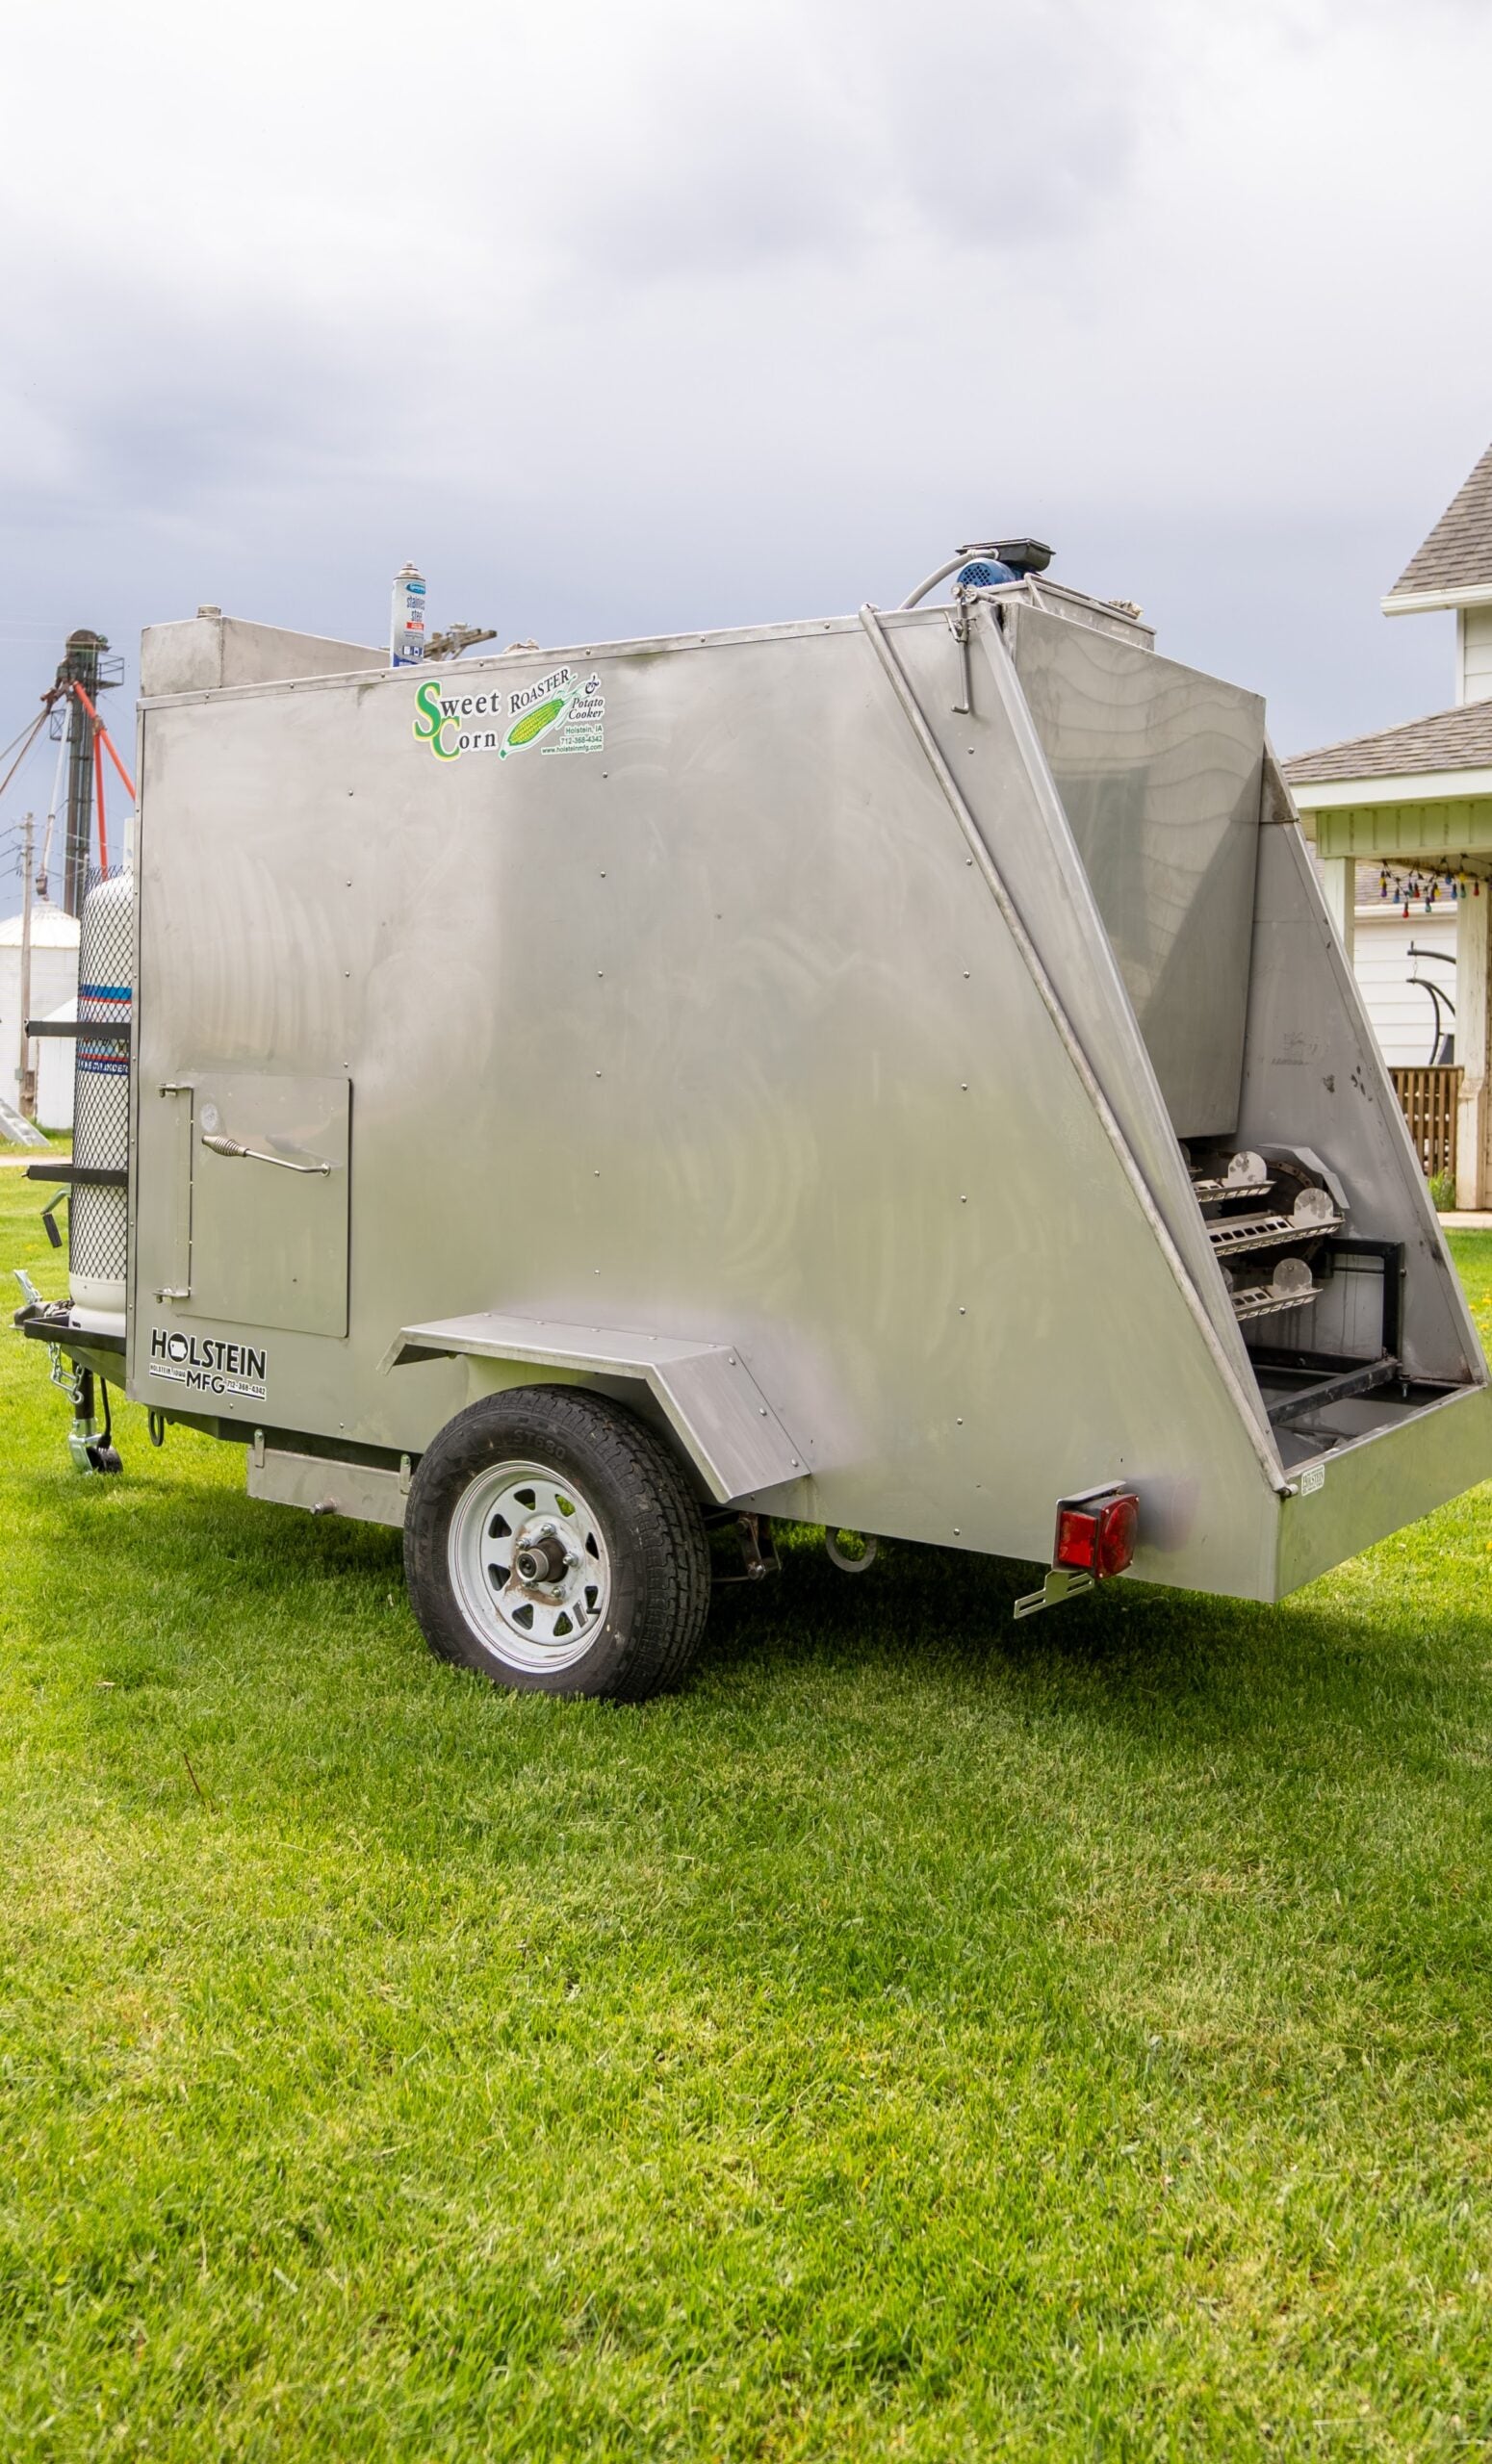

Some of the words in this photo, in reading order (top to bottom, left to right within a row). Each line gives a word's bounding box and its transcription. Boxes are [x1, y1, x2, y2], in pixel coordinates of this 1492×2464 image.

[510, 669, 570, 714] ROASTER
[572, 697, 604, 709] Potato
[414, 681, 500, 739] Sweet
[568, 708, 604, 720] Cooker
[432, 715, 496, 760] Corn
[560, 735, 603, 745] 712-368-4342
[151, 1328, 266, 1380] HOLSTEIN
[186, 1370, 225, 1394] MFG
